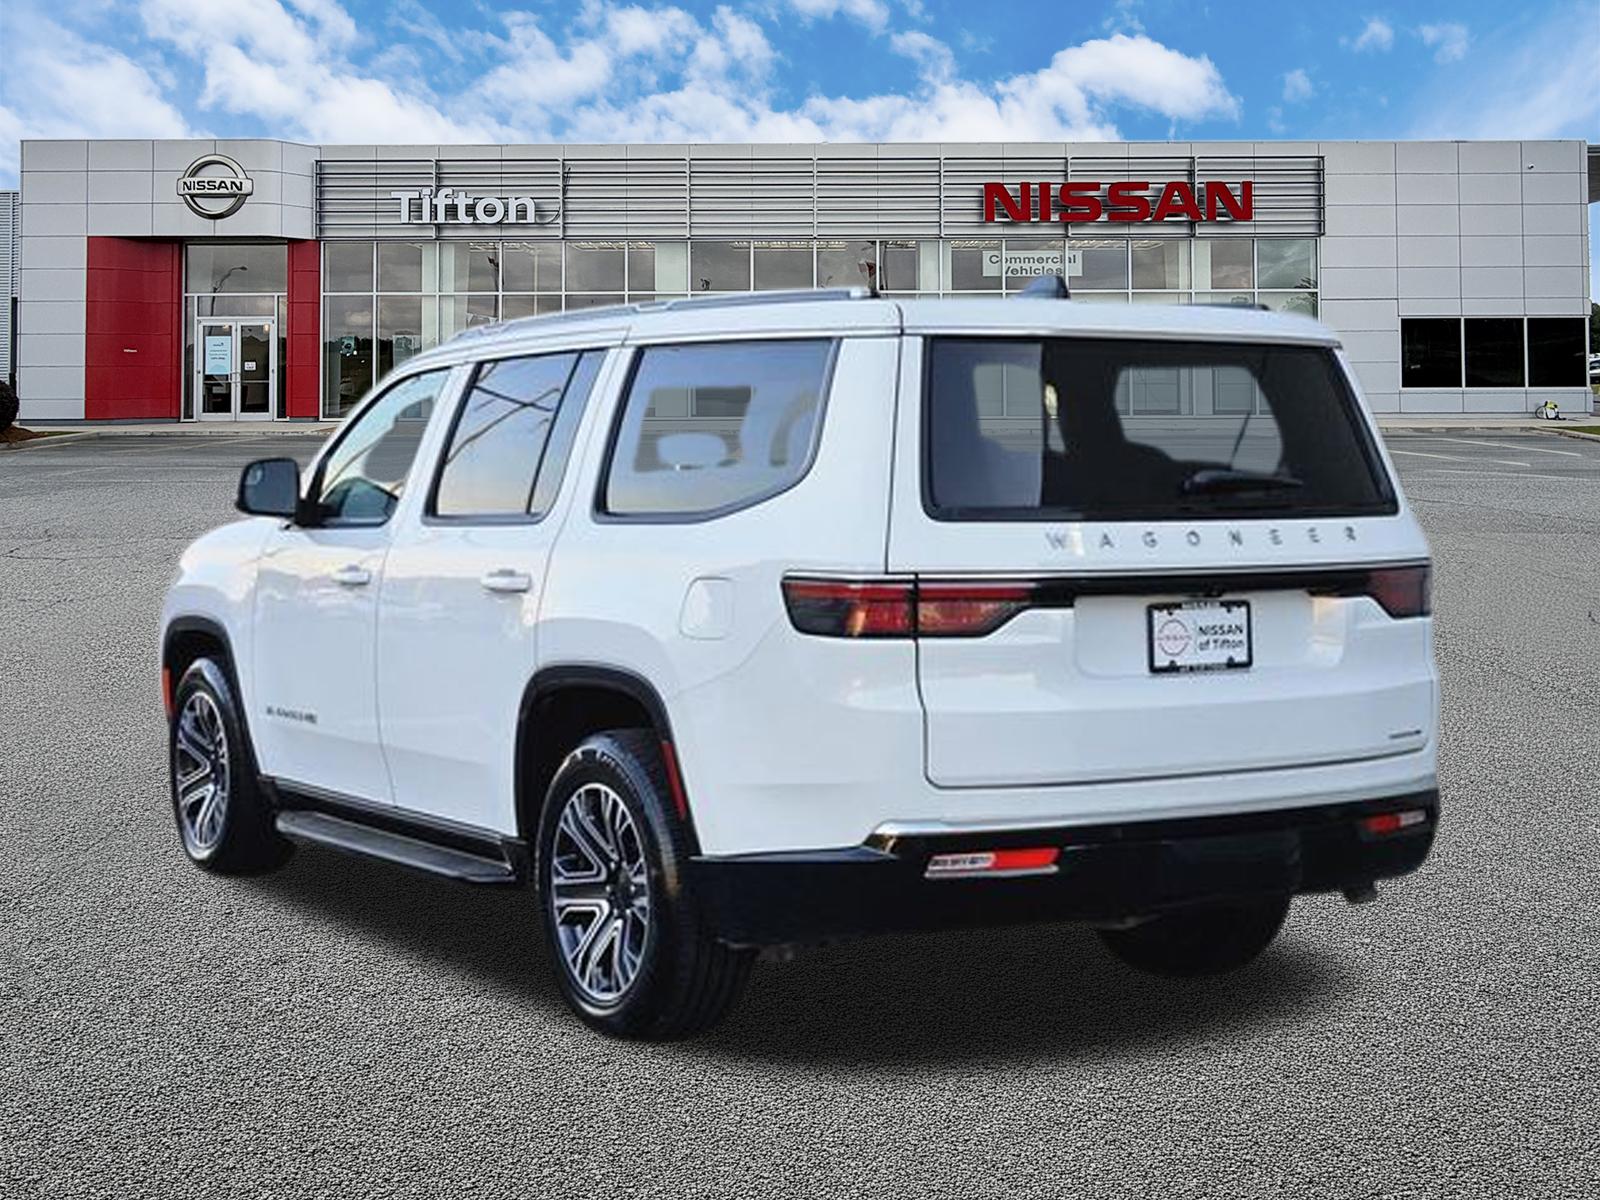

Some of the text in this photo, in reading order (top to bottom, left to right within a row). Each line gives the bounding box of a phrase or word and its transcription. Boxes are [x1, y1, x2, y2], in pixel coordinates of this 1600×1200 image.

[183, 181, 243, 191] NISSAN
[391, 188, 536, 224] Tifton
[983, 181, 1253, 221] NISSAN
[1046, 526, 1357, 549] WAGONEER
[1199, 624, 1243, 636] NISSAN
[1199, 638, 1244, 651] of Tifton
